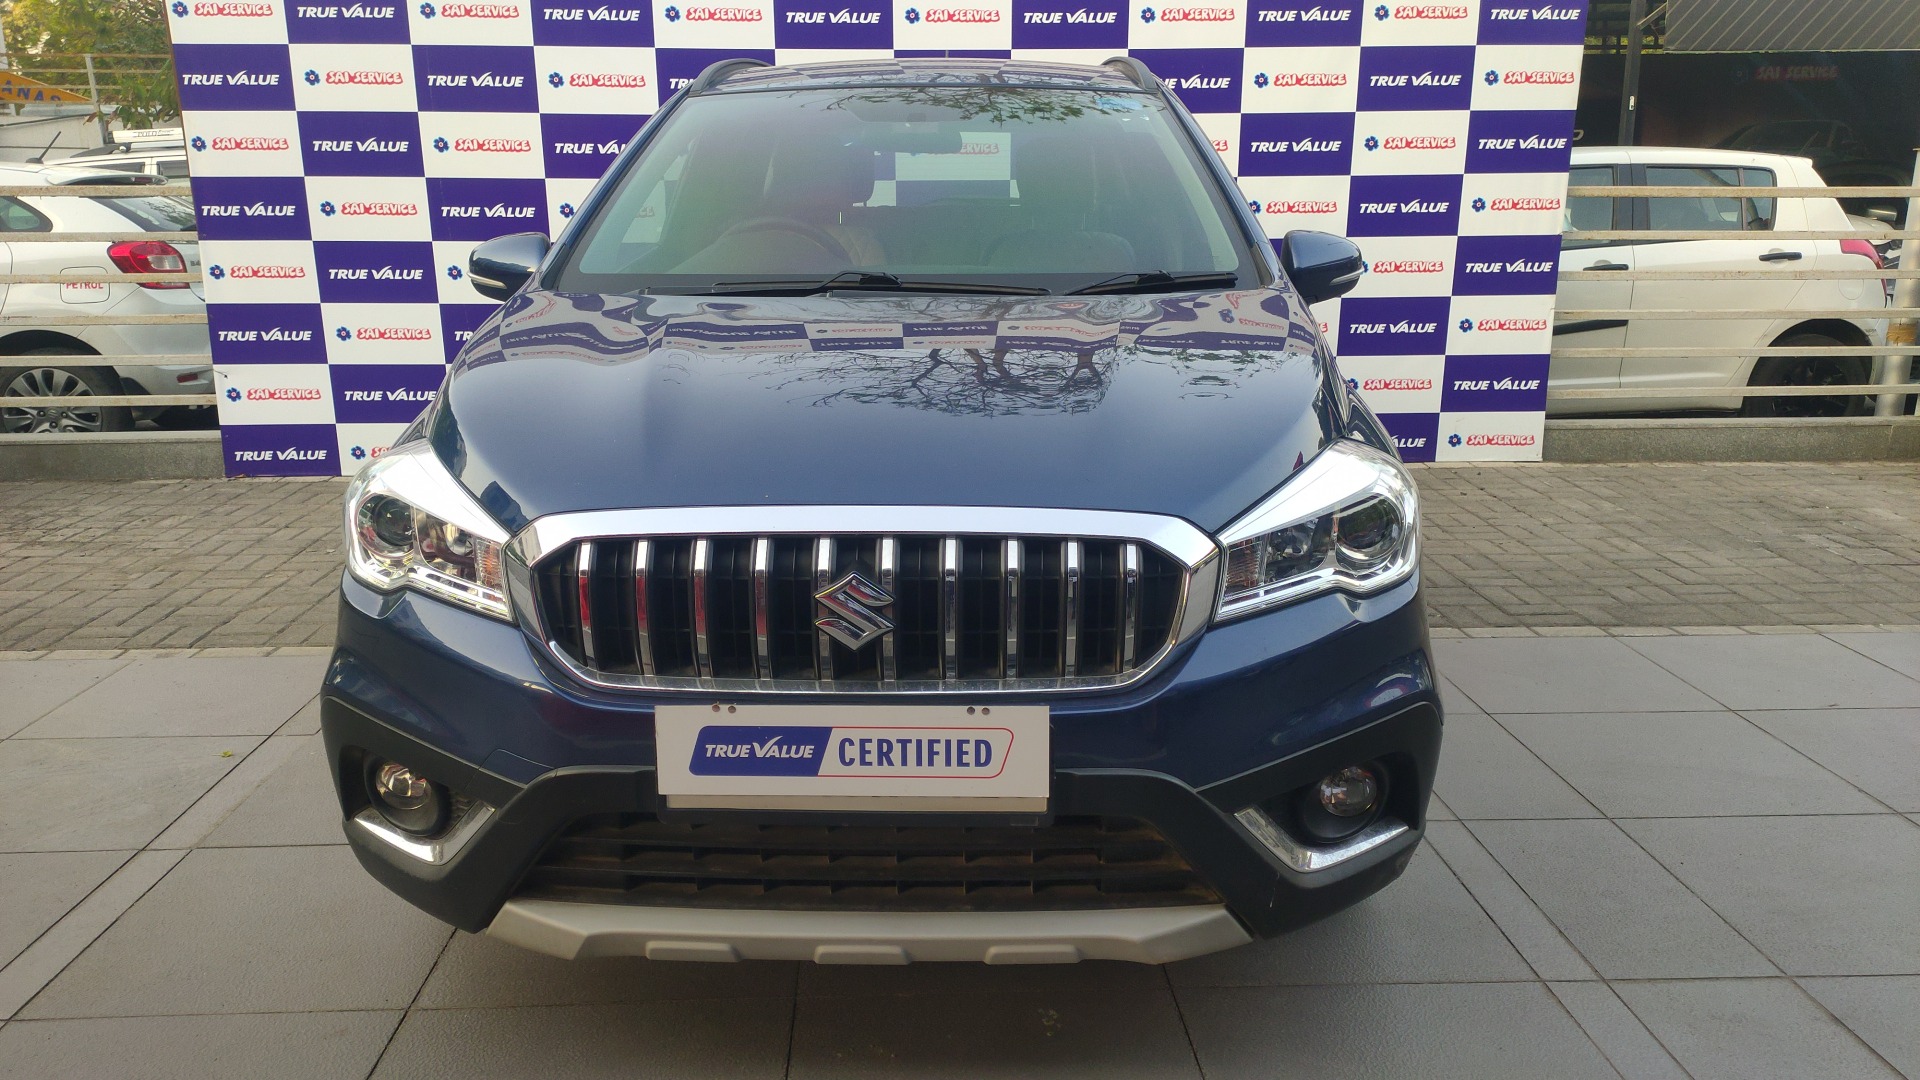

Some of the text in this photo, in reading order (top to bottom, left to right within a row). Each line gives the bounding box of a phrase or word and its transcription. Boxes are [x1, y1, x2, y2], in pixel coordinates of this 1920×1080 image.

[194, 3, 273, 17] SAI SERVICE
[297, 3, 395, 18] TRUE VALUE
[441, 4, 519, 19] SAI SERVICE
[544, 6, 640, 21] TRUE VALUE
[685, 8, 763, 22] SAI SERVICE
[786, 8, 881, 23] TRUE VALUE
[925, 10, 1000, 23] SAI SERVICE
[1024, 8, 1117, 23] TRUE VALUE
[1160, 8, 1235, 22] SAI SERVICE
[1259, 6, 1351, 21] TRUE VALUE
[1394, 6, 1468, 20] SAI SERVICE
[1491, 5, 1581, 20] TRUE VALUE
[183, 70, 279, 85] TRUE VALUE
[325, 72, 403, 85] SAI SERVICE
[427, 72, 524, 87] TRUE VALUE
[569, 74, 646, 88] SAI SERVICE
[1180, 74, 1231, 89] VALUE
[1274, 74, 1347, 87] SAI SERVICE
[1370, 71, 1461, 86] TRUE VALUE
[1503, 72, 1574, 85] SAI SERVICE
[212, 138, 289, 151] SAI SERVICE
[313, 137, 409, 152] TRUE VALUE
[454, 139, 531, 153] SAI SERVICE
[554, 142, 594, 154] TRUE
[960, 143, 1000, 154] ERVICE
[1251, 138, 1341, 152] TRUE VALUE
[1383, 137, 1456, 150] SAI SERVICE
[1479, 139, 1516, 149] TRUE
[1519, 135, 1567, 149] VALUE
[202, 202, 295, 216] TRUE VALUE
[341, 203, 418, 216] SAI SERVICE
[441, 203, 535, 217] TRUE VALUE
[1265, 202, 1338, 214] SAI SERVICE
[1360, 199, 1449, 213] TRUE VALUE
[1490, 198, 1560, 211] SAI SERVICE
[230, 266, 305, 279] SAI SERVICE
[329, 266, 423, 279] TRUE VALUE
[1373, 261, 1444, 274] SAI SERVICE
[1466, 259, 1553, 272] TRUE VALUE
[1350, 320, 1437, 333] TRUE VALUE
[1477, 320, 1547, 332] SAI SERVICE
[219, 327, 312, 341] TRUE VALUE
[356, 328, 431, 341] SAI SERVICE
[1363, 379, 1432, 391] SAI SERVICE
[1454, 377, 1540, 390] TRUE VALUE
[246, 389, 321, 400] SAI SERVICE
[345, 387, 437, 401] TRUE VALUE
[1391, 435, 1427, 448] ALUE
[1466, 434, 1534, 446] SAI SERVICE
[235, 447, 327, 461] TRUE VALUE
[705, 735, 993, 768] TRUE VALUE CERTIFIED
